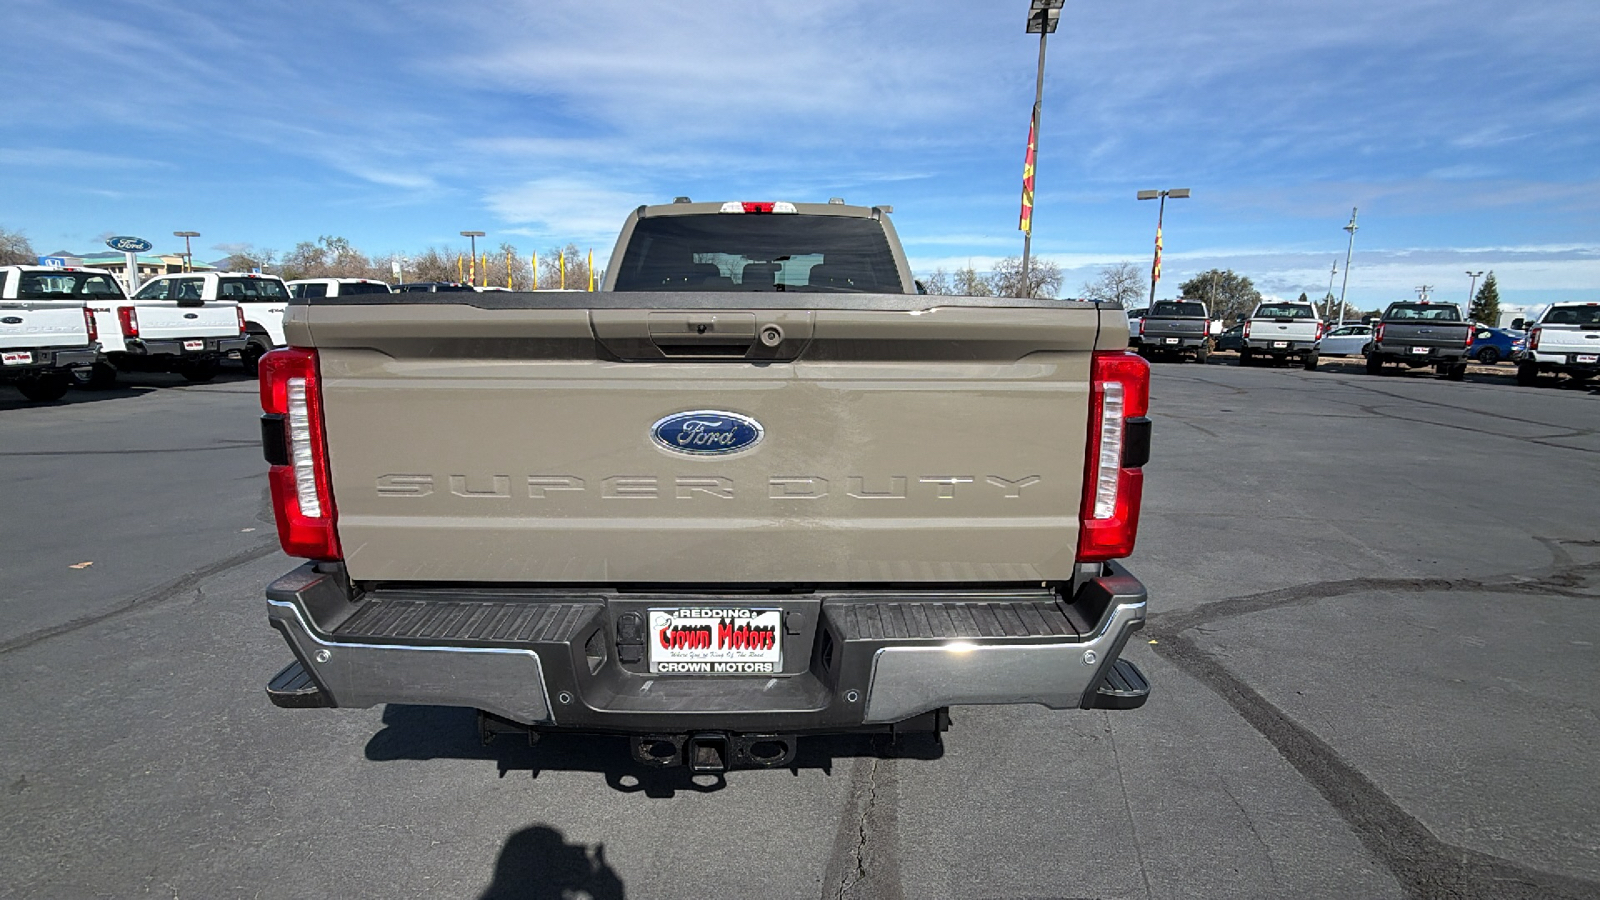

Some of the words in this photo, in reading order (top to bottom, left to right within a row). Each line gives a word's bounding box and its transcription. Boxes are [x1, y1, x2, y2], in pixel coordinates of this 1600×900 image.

[117, 239, 144, 250] Ford
[677, 420, 737, 445] Ford
[376, 474, 733, 498] SUPER
[769, 475, 1040, 499] DUTY
[680, 609, 751, 618] REDDING
[659, 625, 711, 650] Crown
[718, 622, 775, 650] Motors
[658, 662, 711, 672] CROWN
[714, 662, 773, 672] MOTORS
